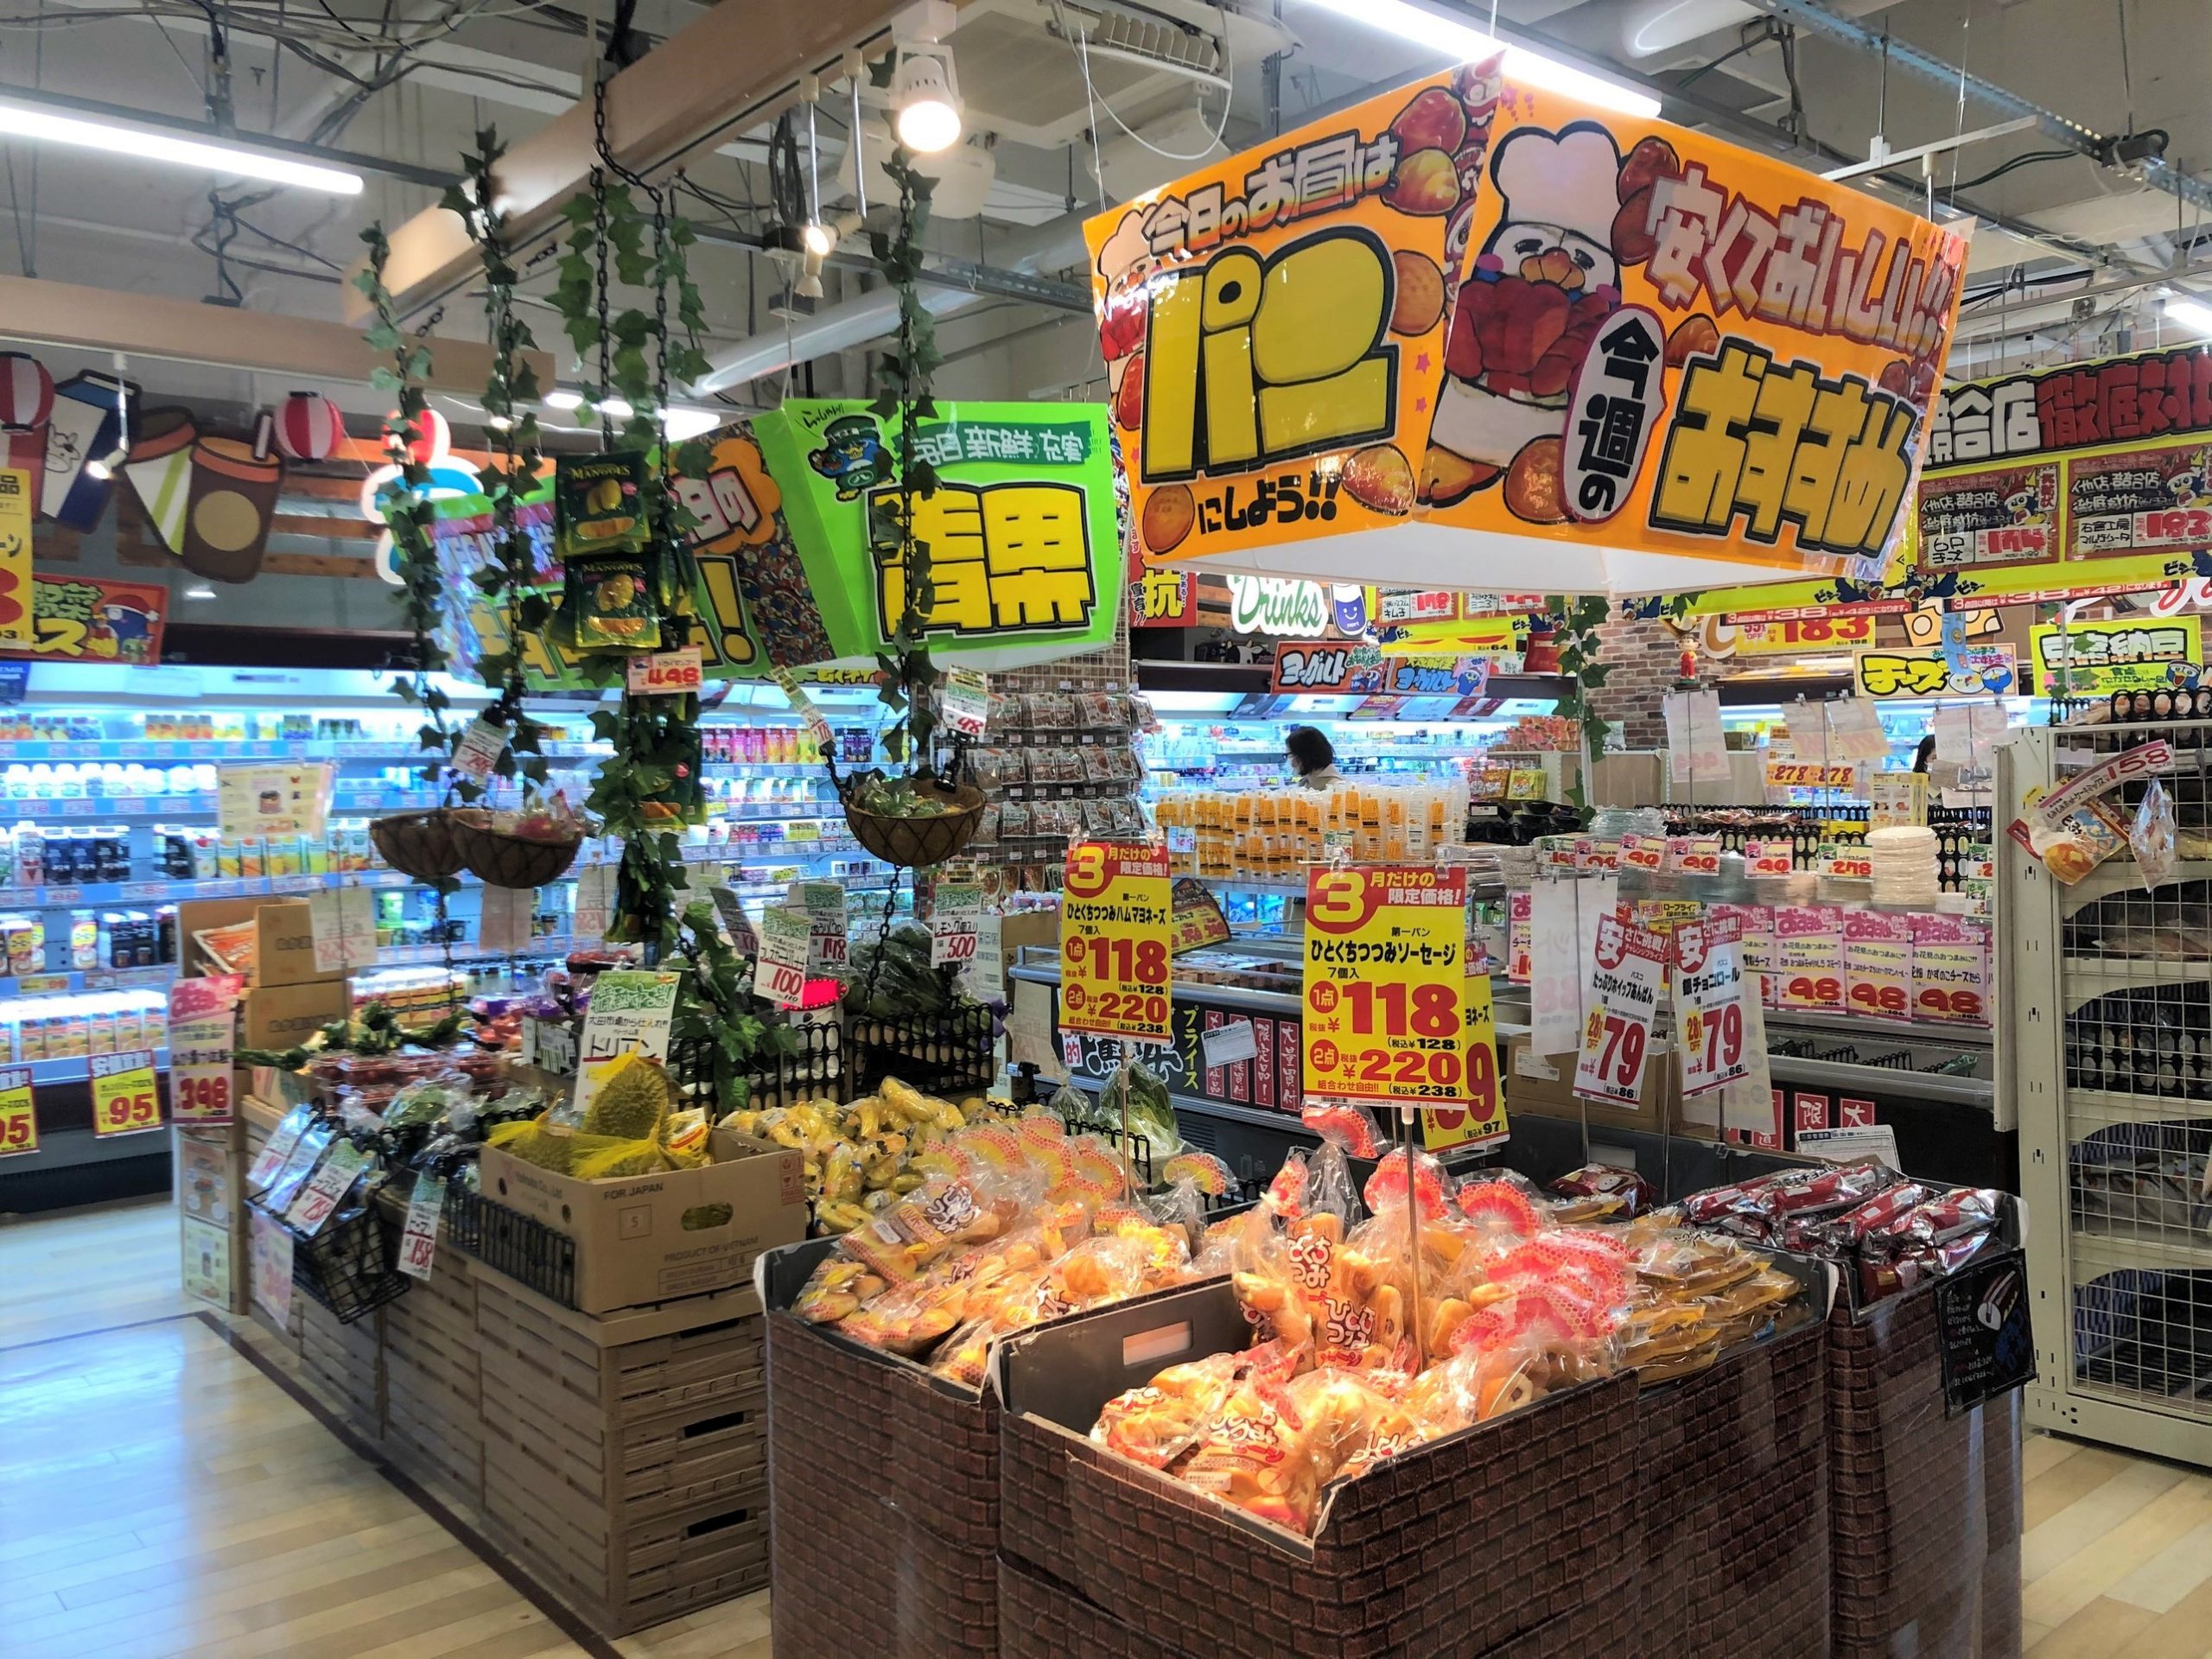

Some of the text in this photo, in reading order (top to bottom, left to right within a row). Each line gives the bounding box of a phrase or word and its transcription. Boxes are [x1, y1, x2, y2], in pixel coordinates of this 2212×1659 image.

[1142, 130, 1402, 257] 今日のお昼は
[1142, 226, 1401, 484] パン
[1579, 316, 1660, 512] 今週の
[1648, 336, 1916, 558] おすすめ
[1141, 569, 1184, 619] 抗
[1235, 574, 1323, 628] Drinks
[1783, 616, 1870, 644] 183
[648, 666, 700, 684] 498
[1280, 649, 1347, 687] ヨーグルト
[1395, 669, 1458, 692] ヨーグルト
[1861, 655, 1949, 695] チーズ
[1774, 765, 1808, 780] 278
[2107, 748, 2171, 780] 158
[1069, 846, 1105, 890] 3
[1628, 851, 1660, 865] 90
[1682, 855, 1719, 869] 90
[1756, 859, 1790, 872] 90
[1832, 861, 1872, 875] 278
[1313, 872, 1435, 923] 3 月だけの
[1388, 888, 1461, 906] 限定価格!
[947, 936, 977, 958] 500
[1391, 926, 1431, 938] 第一パン
[1599, 919, 1624, 965] 安
[1679, 925, 1703, 969] 安
[1088, 936, 1168, 985] 118
[1311, 939, 1457, 967] ひとくちつつみソーセージ
[771, 967, 804, 996] 100
[1327, 966, 1360, 979] 7個入
[1788, 977, 1841, 1001] 98
[1851, 982, 1907, 1011] 98
[1919, 988, 1982, 1014] 98
[1098, 992, 1167, 1023] 220
[1313, 988, 1336, 1007] 1点
[1342, 981, 1460, 1038] 118
[1183, 1004, 1200, 1090] プライス
[1598, 1015, 1646, 1087] 79
[1703, 1003, 1743, 1073] 79
[1313, 1047, 1336, 1065] 2点
[1359, 1048, 1462, 1085] 220
[109, 1092, 154, 1126] 95
[1843, 1104, 1871, 1126] 大
[604, 1182, 664, 1200] FOR JAPAN
[664, 1247, 708, 1262] PRODUCT
[709, 1245, 721, 1256] OF
